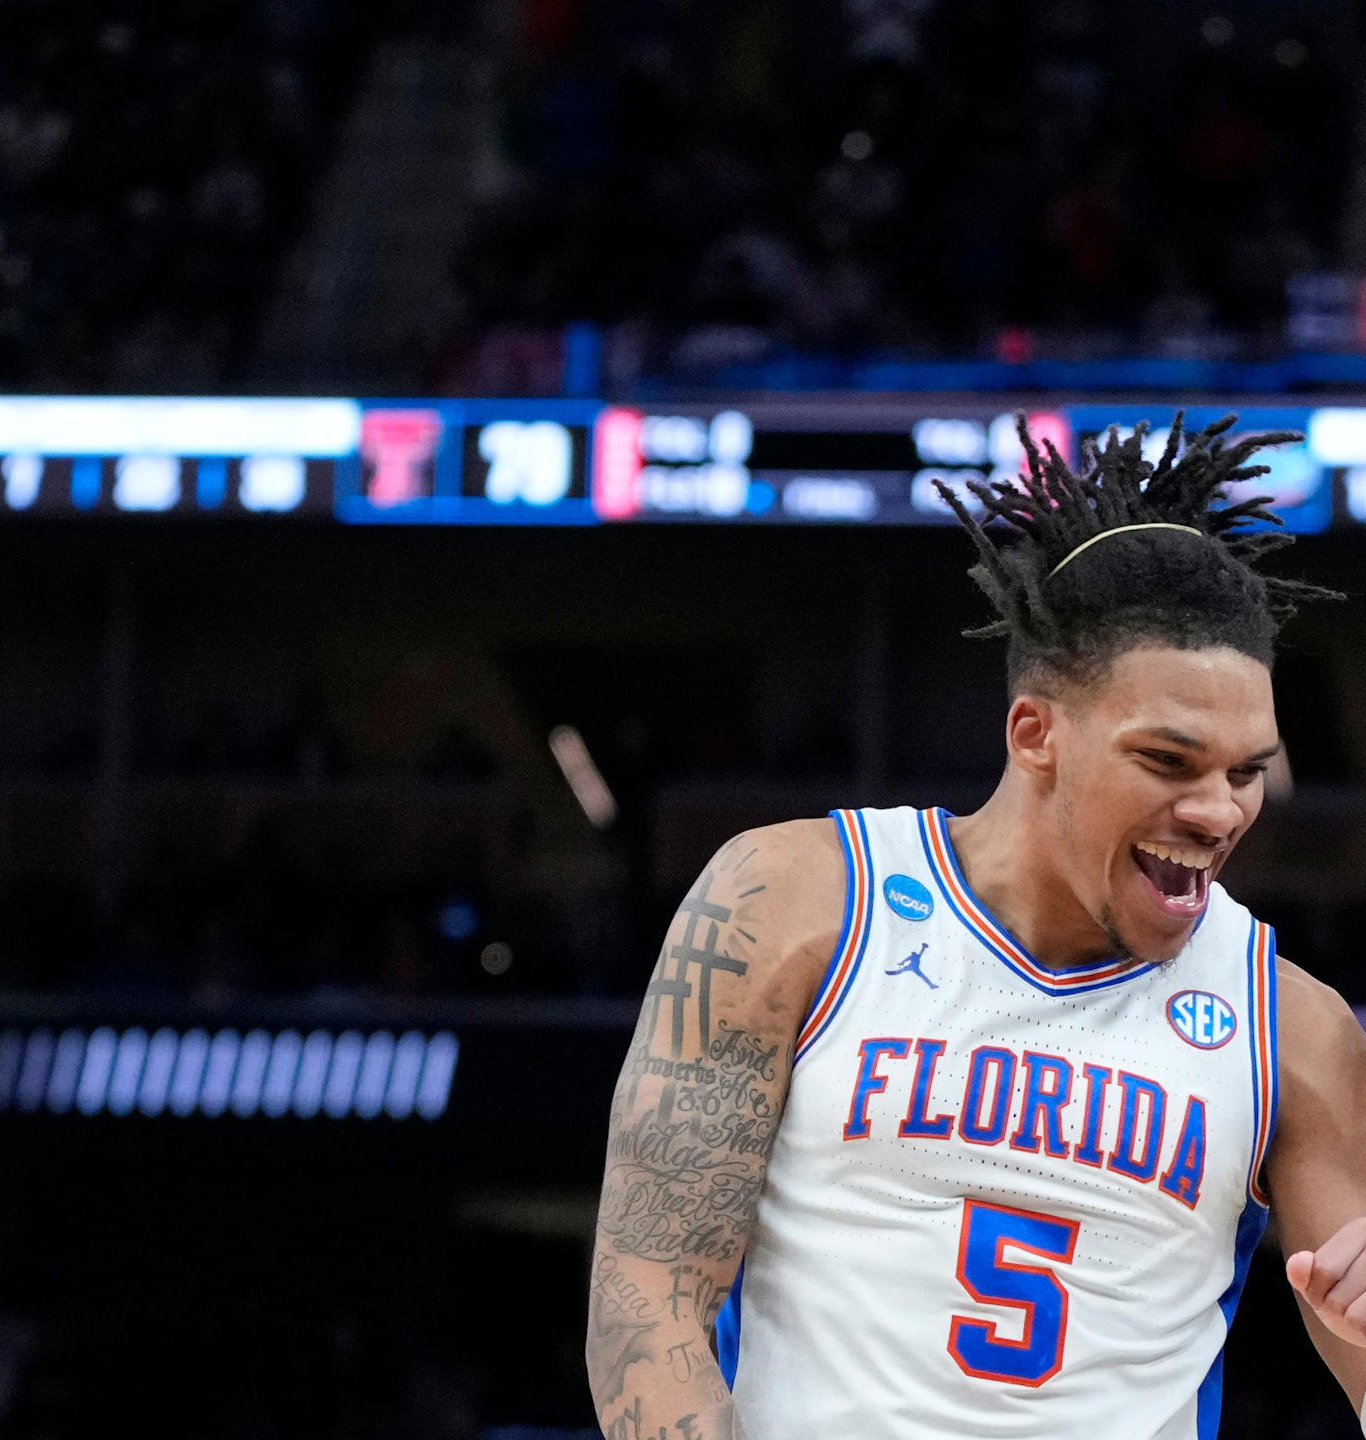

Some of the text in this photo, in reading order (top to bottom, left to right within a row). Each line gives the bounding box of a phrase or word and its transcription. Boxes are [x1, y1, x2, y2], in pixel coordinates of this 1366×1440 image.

[888, 888, 930, 914] NCAA
[1173, 992, 1232, 1044] SEC
[842, 1036, 1207, 1210] FLORIDA
[947, 1197, 1081, 1388] 5
